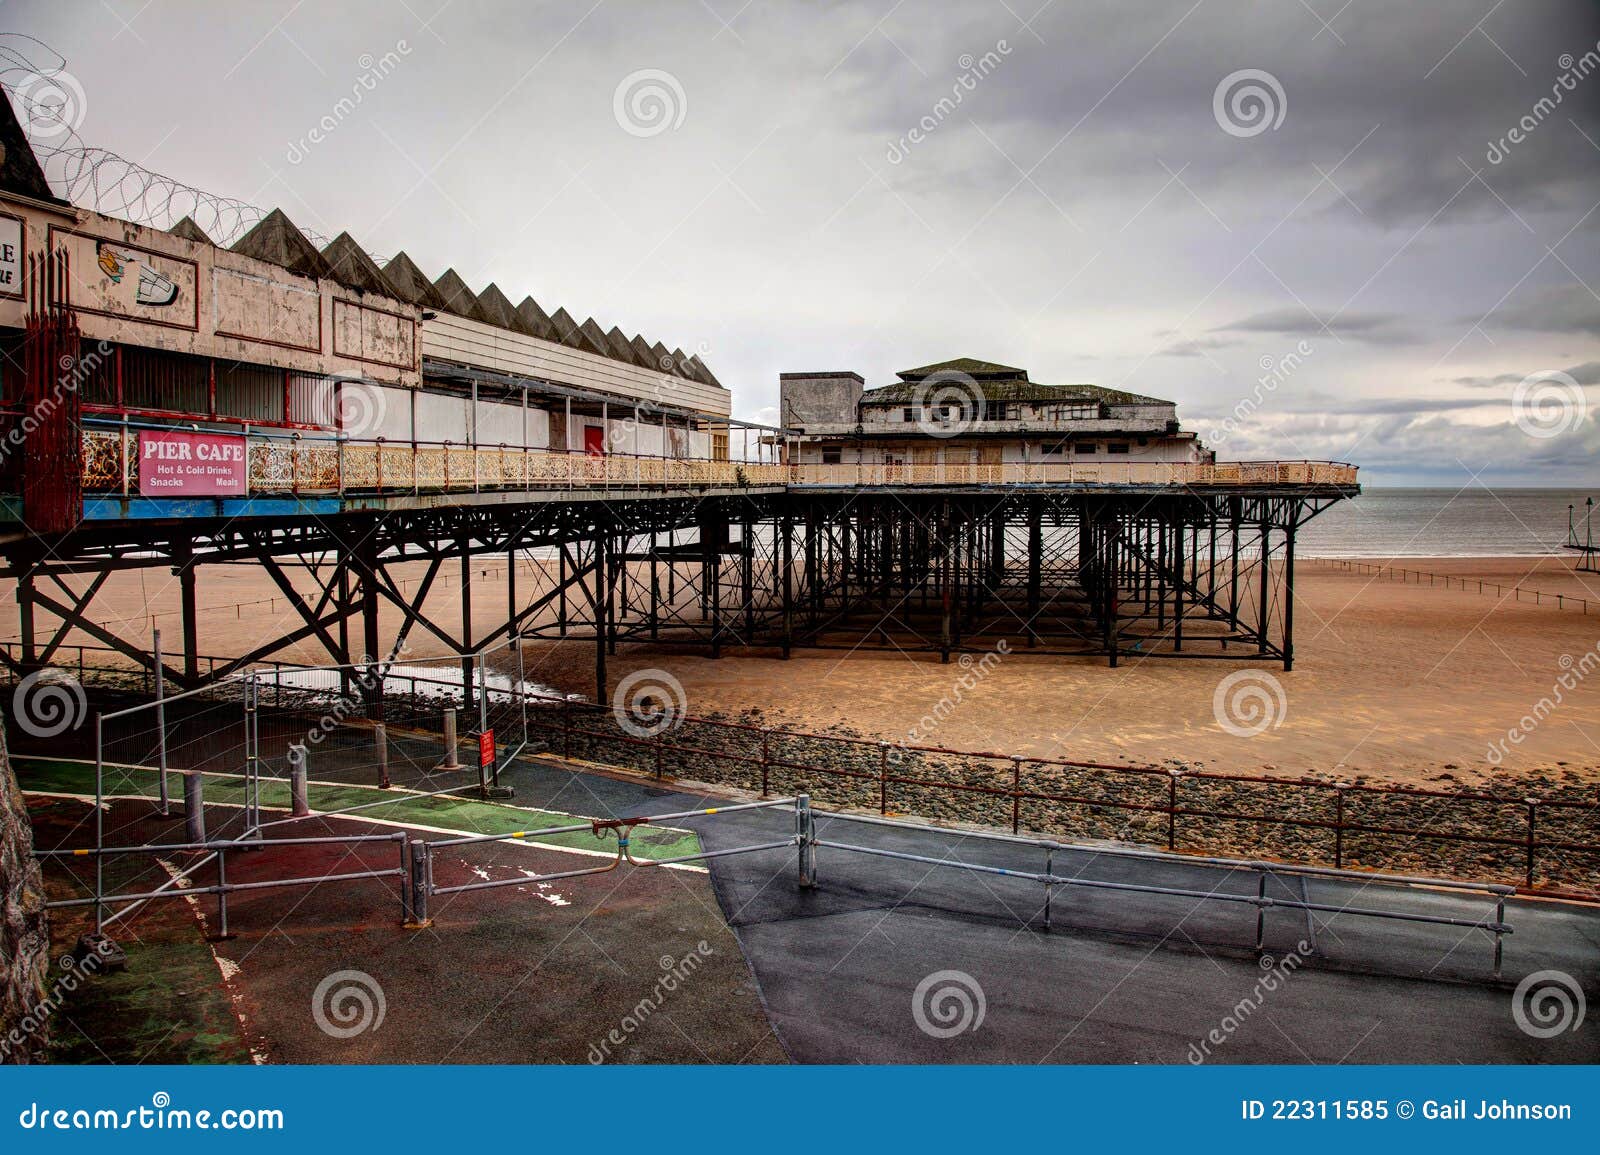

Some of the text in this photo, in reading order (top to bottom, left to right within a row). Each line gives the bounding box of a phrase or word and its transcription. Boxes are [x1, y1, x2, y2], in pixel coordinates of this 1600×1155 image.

[143, 441, 244, 461] PIER CAFE
[157, 465, 232, 475] Hot & Cold Drinks
[150, 477, 238, 487] Snacks Meals
